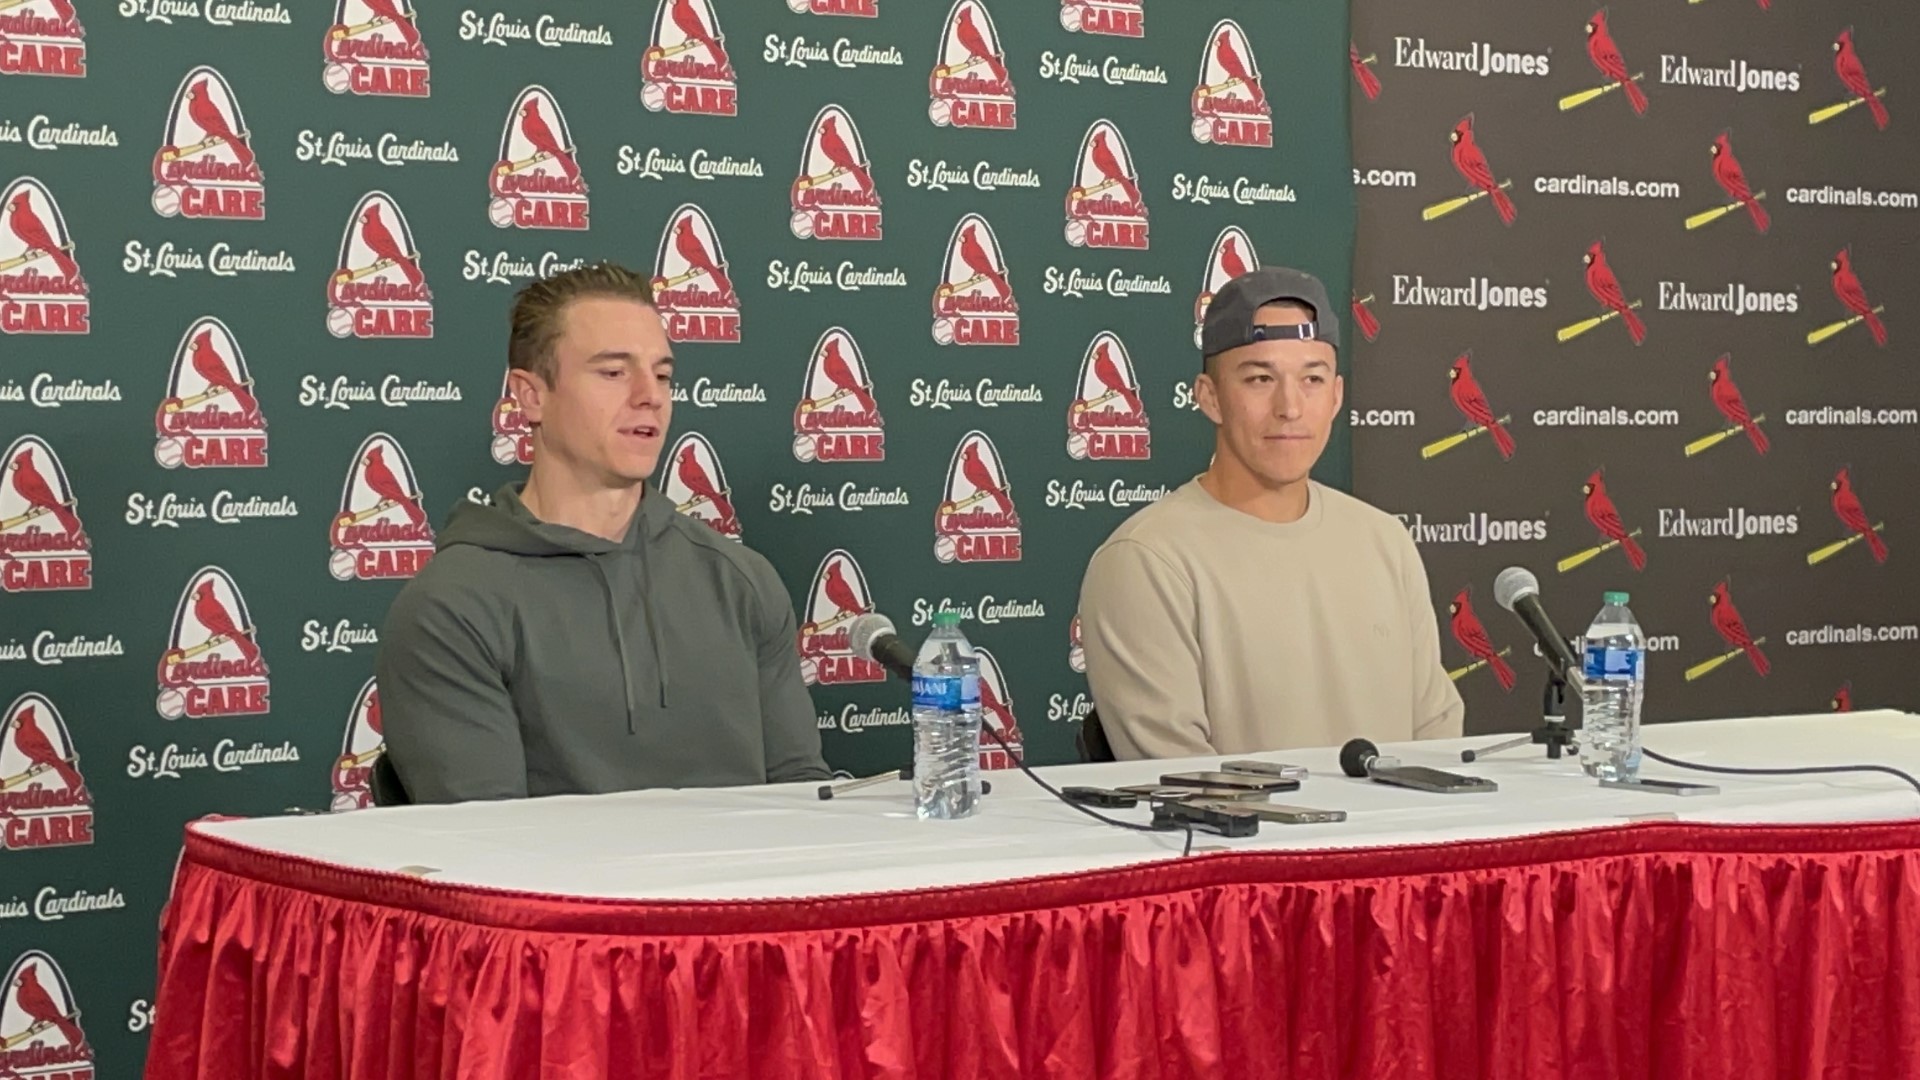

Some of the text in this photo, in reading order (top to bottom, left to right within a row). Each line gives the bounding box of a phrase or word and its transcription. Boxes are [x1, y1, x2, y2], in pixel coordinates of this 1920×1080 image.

[535, 15, 613, 47] Cardinals
[1082, 7, 1142, 36] CARE
[0, 42, 83, 75] CARE
[833, 38, 903, 68] Cardinals
[351, 64, 427, 96] CARE
[1103, 56, 1168, 85] Cardinals
[666, 84, 734, 114] CARE
[952, 99, 1013, 127] CARE
[27, 115, 119, 150] Cardinals
[1213, 118, 1269, 145] CARE
[377, 133, 459, 165] Cardinals
[690, 149, 764, 180] Cardinals
[973, 161, 1040, 190] Cardinals
[1233, 177, 1296, 205] Cardinals
[1534, 174, 1679, 198] cardinals.com
[1786, 186, 1918, 208] cardinals.com
[182, 186, 262, 218] CARE
[515, 199, 586, 228] CARE
[814, 211, 879, 238] CARE
[1087, 222, 1146, 248] CARE
[208, 243, 295, 276] Cardinals
[836, 261, 907, 291] Cardinals
[1107, 269, 1171, 297] Cardinals
[2, 301, 87, 332] CARE
[355, 307, 430, 336] CARE
[668, 314, 737, 341] CARE
[955, 318, 1016, 343] CARE
[30, 373, 122, 407] Cardinals
[380, 375, 462, 407] Cardinals
[692, 377, 767, 407] Cardinals
[976, 378, 1043, 407] Cardinals
[1533, 406, 1678, 425] cardinals.com
[1786, 406, 1917, 425] cardinals.com
[185, 438, 265, 467] CARE
[817, 434, 881, 460] CARE
[1089, 434, 1147, 458] CARE
[211, 490, 298, 523] Cardinals
[839, 482, 909, 511] Cardinals
[1391, 512, 1547, 544] dwardJones
[957, 536, 1018, 561] CARE
[4, 560, 89, 590] CARE
[978, 595, 1045, 624] Cardinals
[32, 631, 124, 665] Cardinals
[1786, 624, 1918, 645] cardinals.com
[187, 689, 267, 718] CARE
[841, 704, 913, 733] Cardinals
[213, 739, 300, 772] Cardinals
[7, 818, 90, 848] CARE
[34, 886, 125, 921] Cardinals
